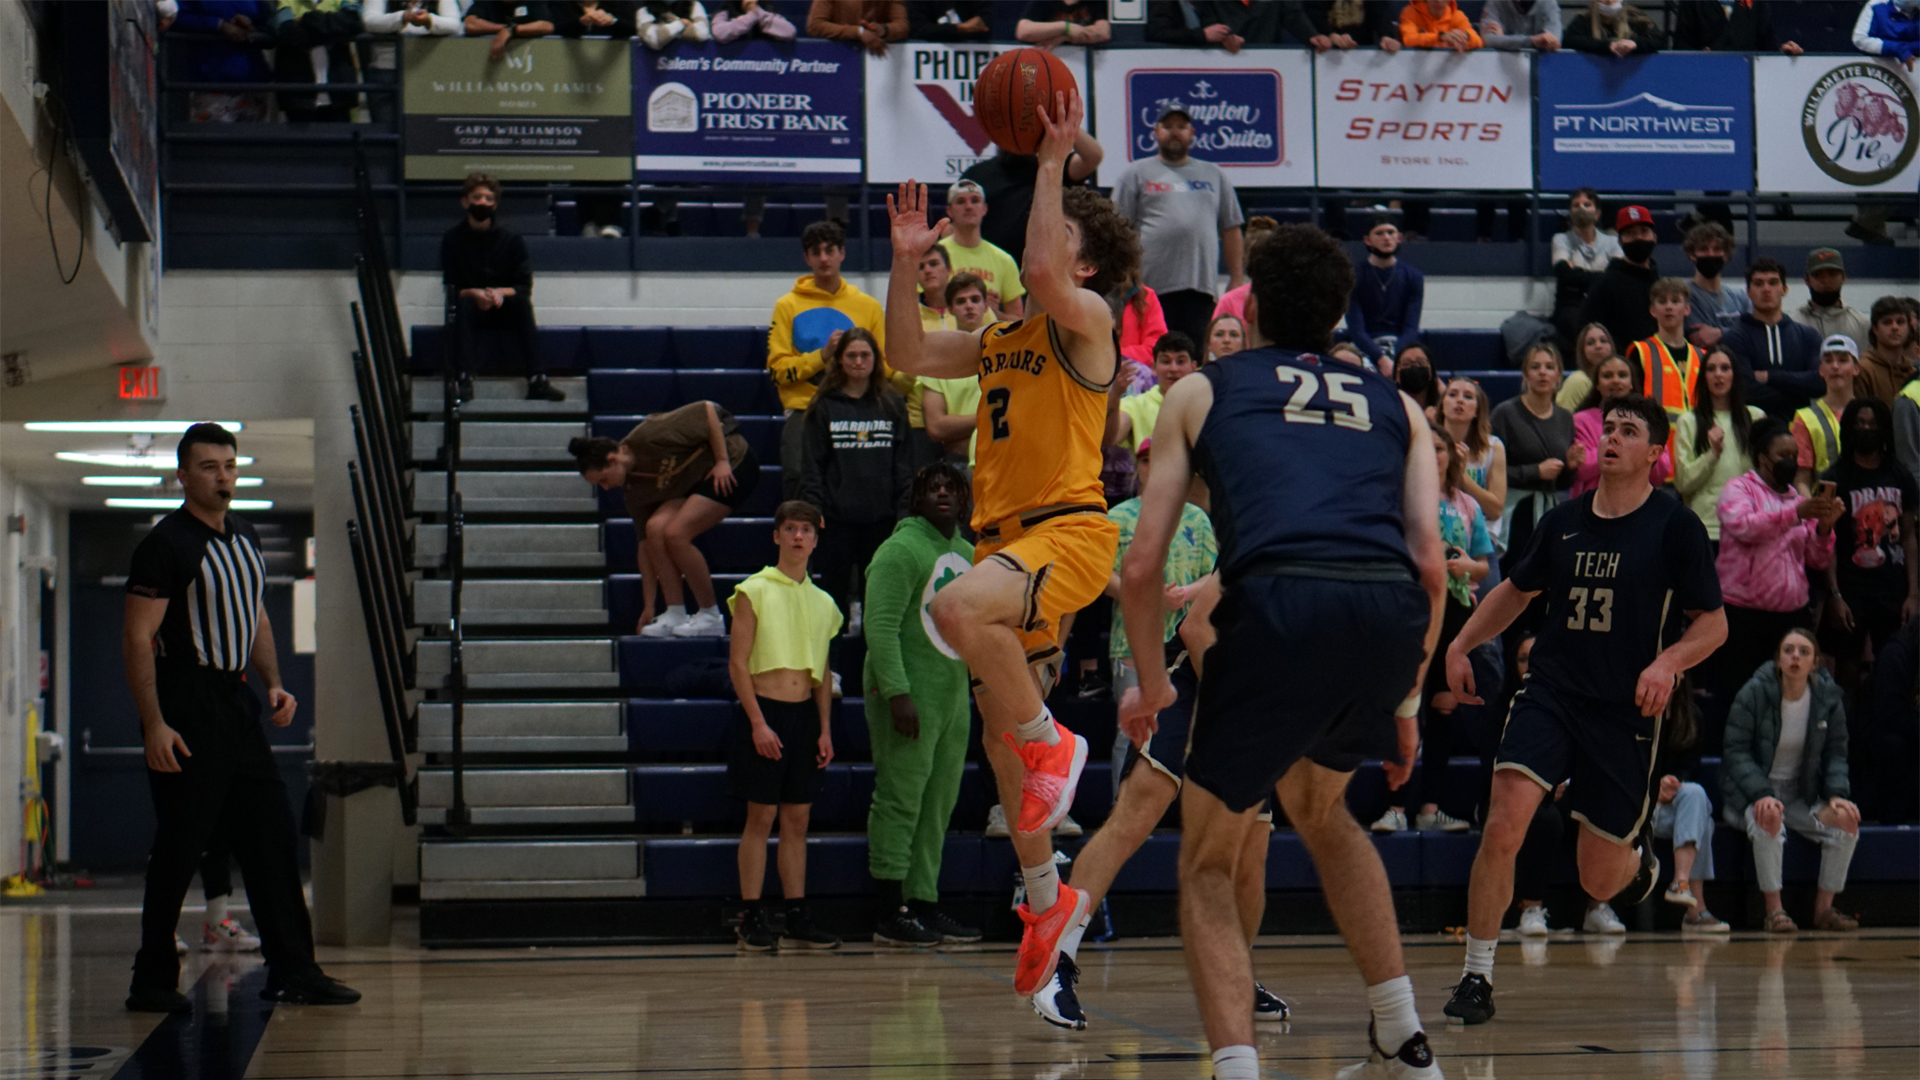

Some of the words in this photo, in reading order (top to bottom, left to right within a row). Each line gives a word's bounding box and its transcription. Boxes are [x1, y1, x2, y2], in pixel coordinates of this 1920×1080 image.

[657, 57, 710, 71] Salem's
[712, 57, 789, 75] Community
[790, 58, 840, 74] Partner
[915, 50, 1000, 80] PHOE
[433, 81, 545, 93] WILLIAMSON
[553, 82, 604, 93] JAMES
[1335, 79, 1512, 103] STAYTON
[1803, 66, 1862, 127] WILLAMETTE
[1866, 66, 1911, 99] VALLEY
[702, 92, 812, 111] PIONEER
[1142, 97, 1260, 128] mpton
[454, 125, 490, 135] GARY
[495, 125, 583, 136] WILLIAMSON
[701, 112, 780, 130] TRUST
[782, 114, 849, 132] BANK
[1345, 117, 1503, 142] SPORTS
[1553, 115, 1585, 132] PT
[1589, 115, 1736, 134] NORTHWEST
[1210, 126, 1273, 150] Suites
[1826, 115, 1882, 162] Pie
[1380, 155, 1432, 166] STORE
[119, 366, 161, 398] EXIT
[1275, 365, 1373, 432] 25
[986, 386, 1011, 441] 2
[829, 420, 893, 432] WARRIORS
[833, 440, 892, 449] SOFTBALL
[1574, 551, 1621, 578] TECH
[1566, 586, 1614, 633] 33
